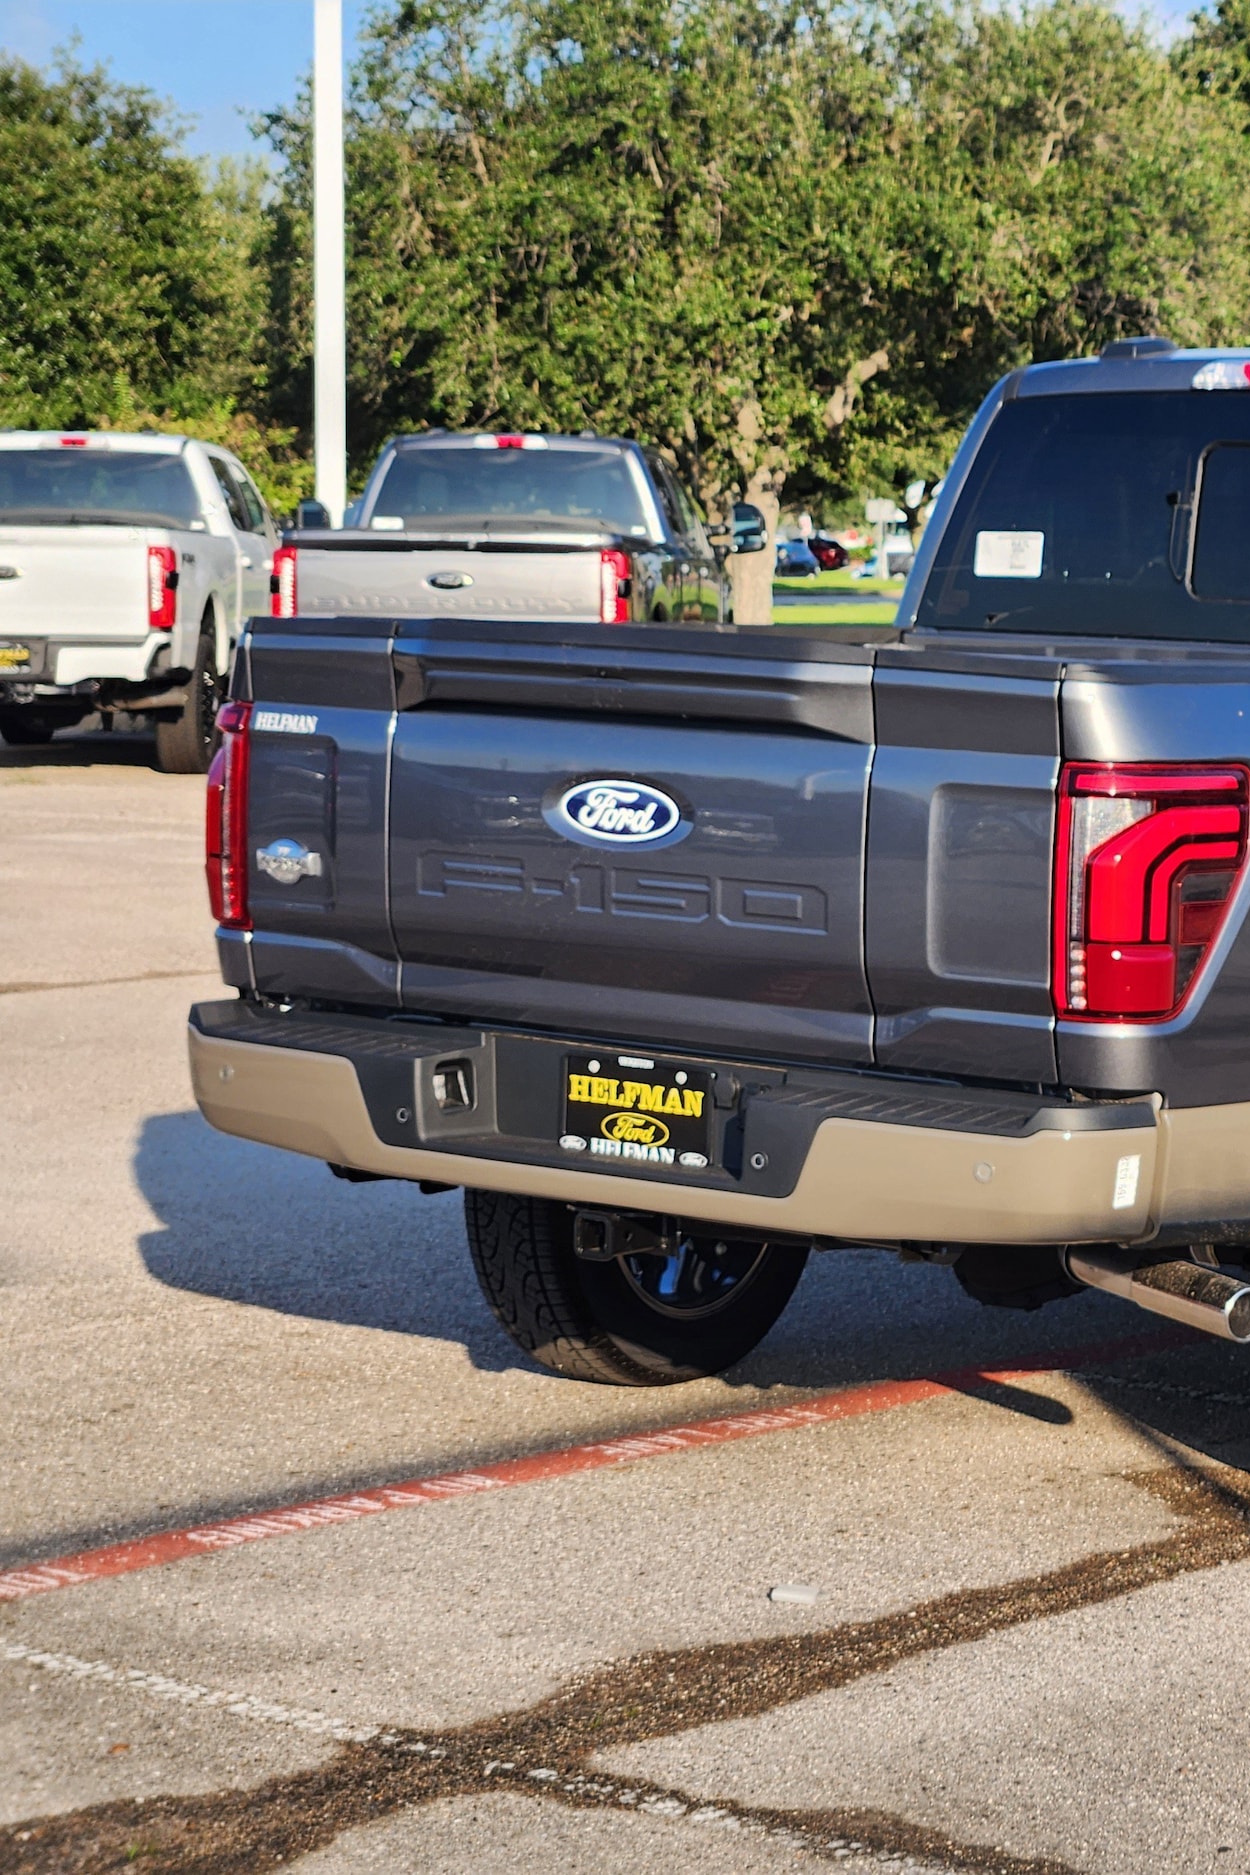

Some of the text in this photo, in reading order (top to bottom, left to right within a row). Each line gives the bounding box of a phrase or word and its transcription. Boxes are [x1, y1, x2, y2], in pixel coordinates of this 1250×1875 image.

[254, 711, 319, 734] HELFMAN
[577, 786, 655, 833] Ford
[416, 849, 829, 936] F-150
[568, 1073, 705, 1118] HELFMAN
[590, 1136, 676, 1165] HELFMAN
[611, 1114, 656, 1144] Ford
[186, 1489, 431, 1547] PARKING
